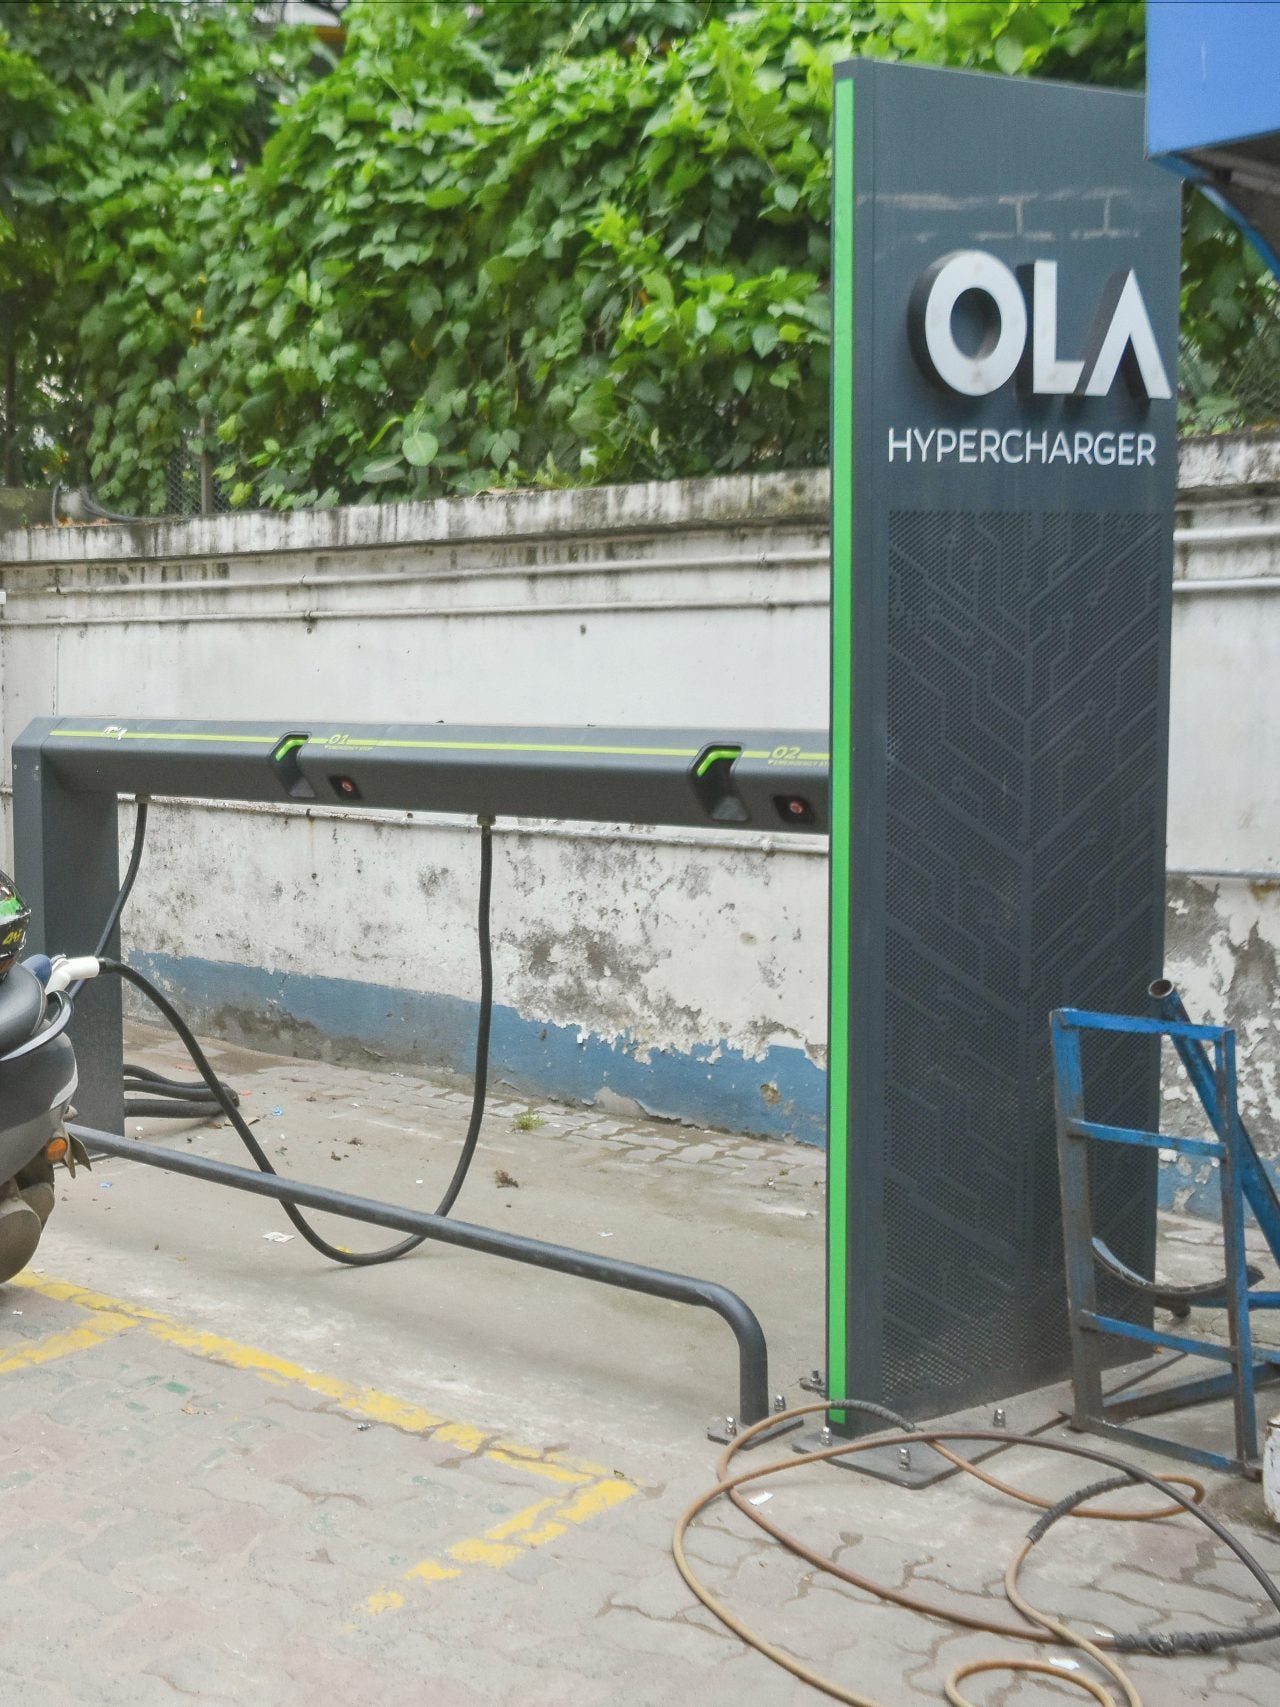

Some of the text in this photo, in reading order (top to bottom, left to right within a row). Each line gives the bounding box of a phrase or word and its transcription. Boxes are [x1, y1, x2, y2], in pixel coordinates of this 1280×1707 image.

[924, 248, 1173, 400] OLA
[887, 426, 1157, 467] HYPERCHARGER
[328, 734, 350, 745] 01
[771, 745, 801, 759] 02
